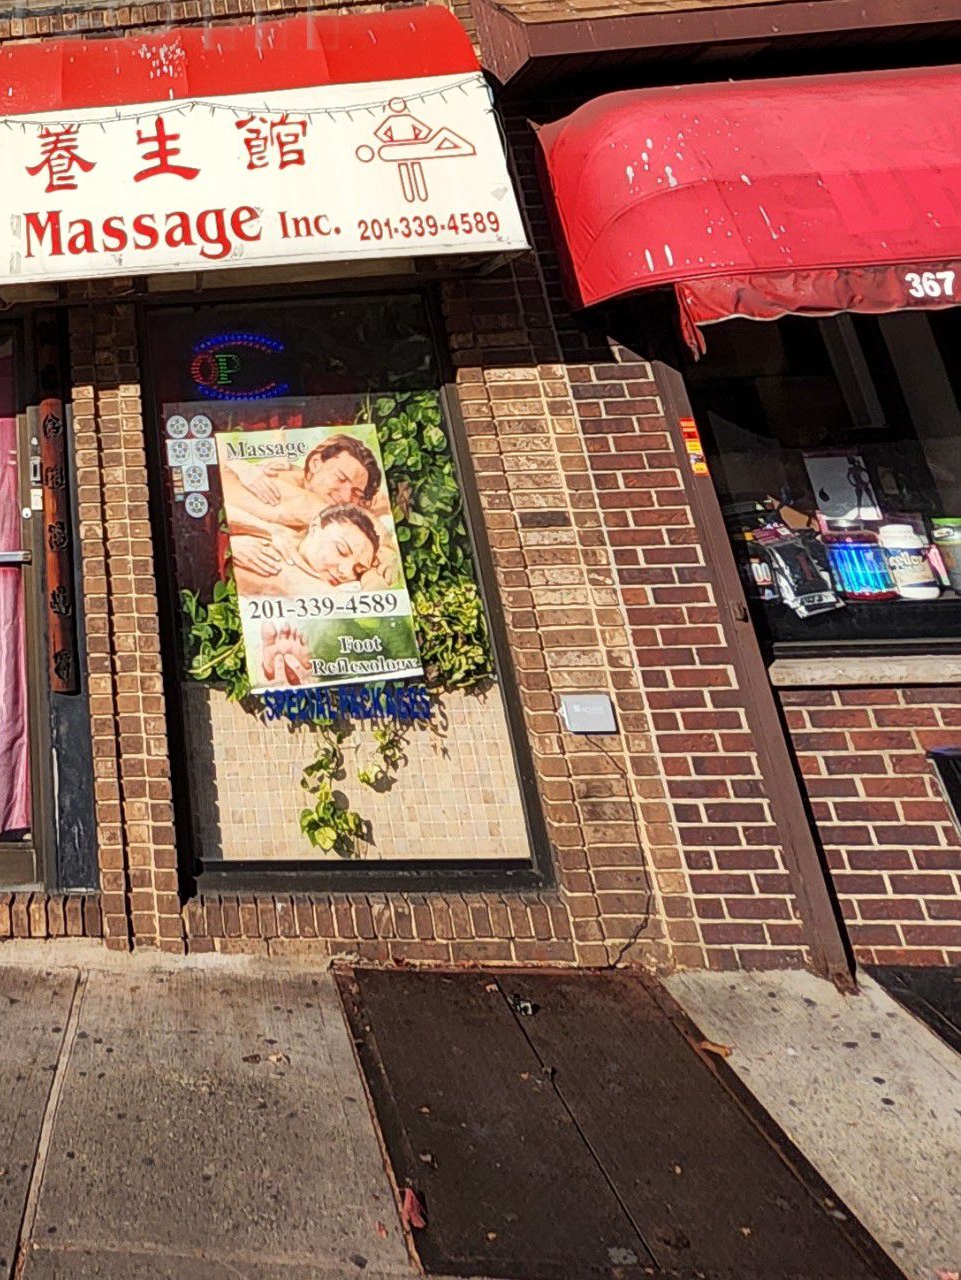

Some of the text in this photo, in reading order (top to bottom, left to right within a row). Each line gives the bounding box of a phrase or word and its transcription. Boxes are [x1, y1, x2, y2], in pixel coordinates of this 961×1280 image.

[23, 204, 263, 260] Massage
[279, 210, 343, 240] Inc.
[904, 271, 956, 298] 367
[225, 440, 307, 461] Massage
[249, 593, 398, 620] 201-339-4589
[338, 635, 382, 654] Foot
